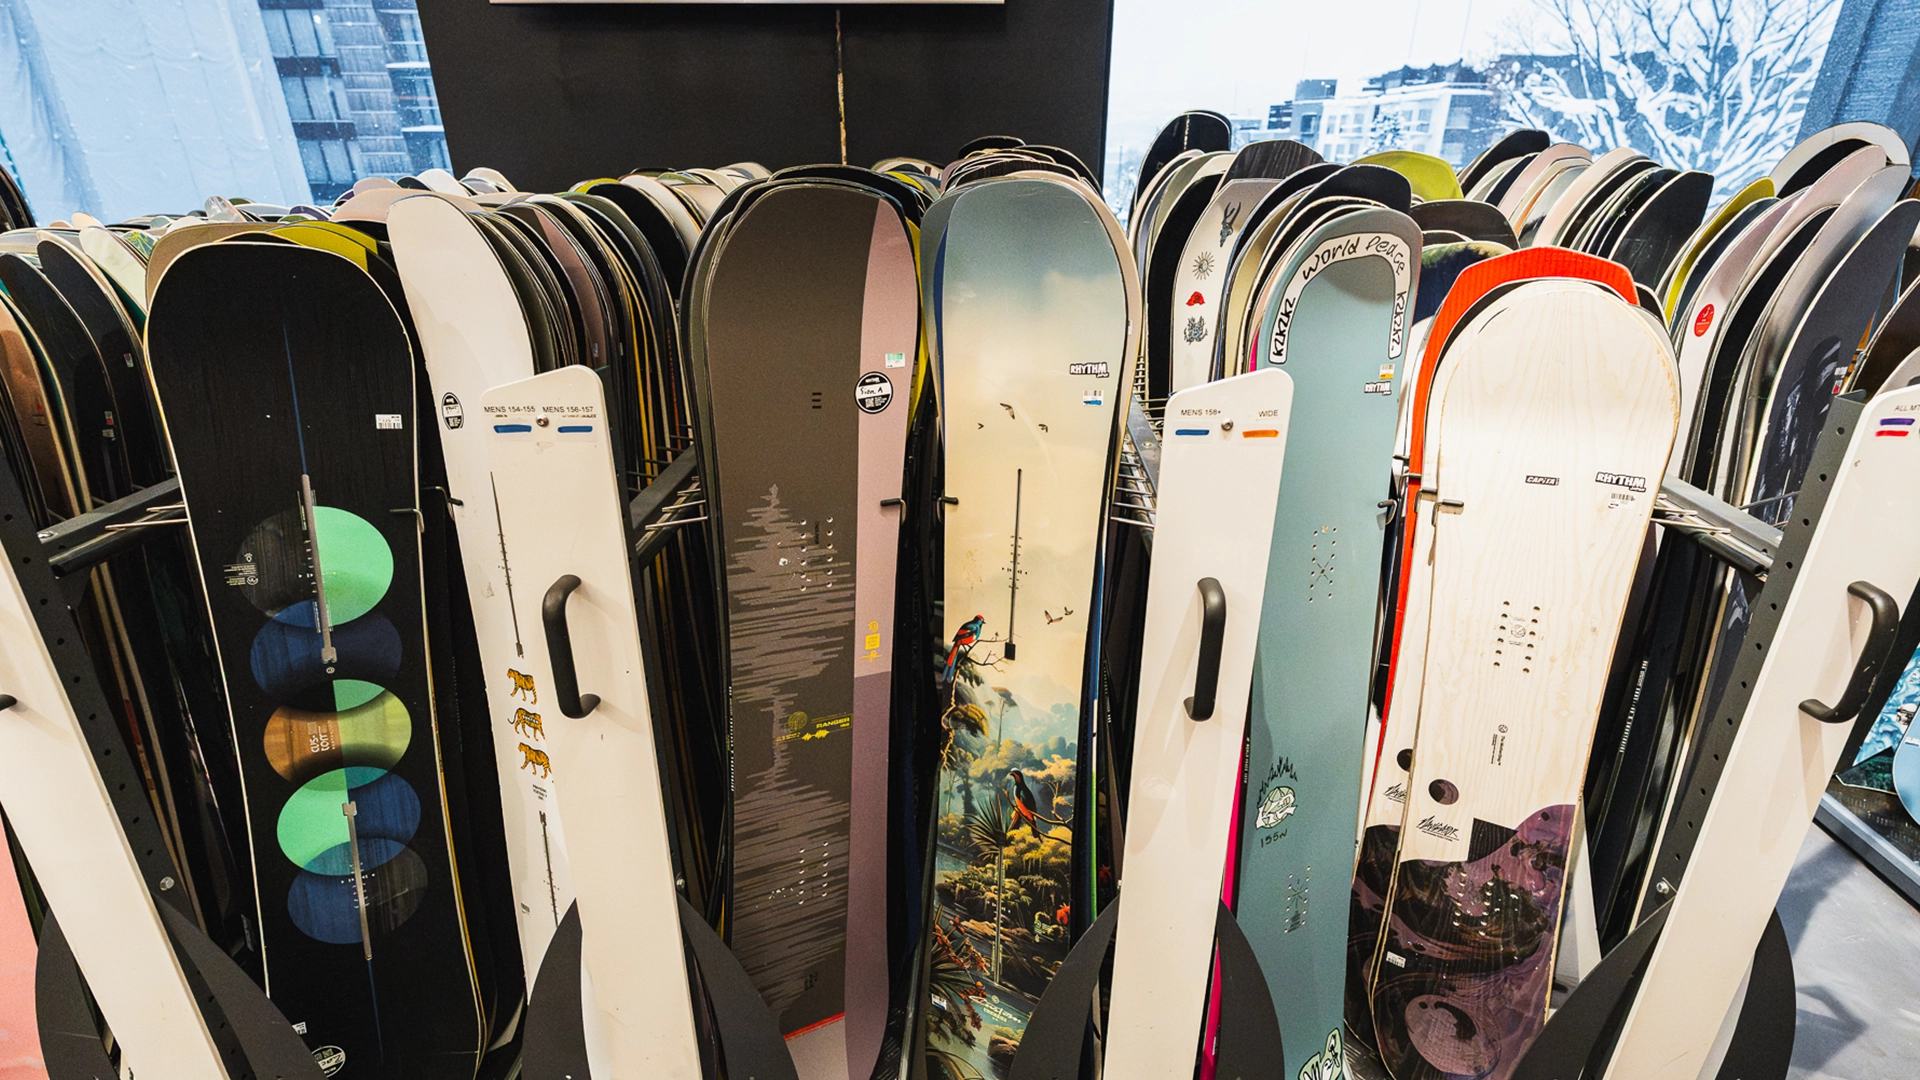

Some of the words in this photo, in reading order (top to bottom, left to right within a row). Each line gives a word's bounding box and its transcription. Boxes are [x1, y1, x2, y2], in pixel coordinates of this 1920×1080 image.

[1069, 361, 1107, 375] RHYTHM
[1258, 410, 1279, 418] WIDE
[1894, 404, 1908, 412] ALL
[1595, 471, 1646, 489] RHYTHM
[815, 717, 851, 729] RANGER
